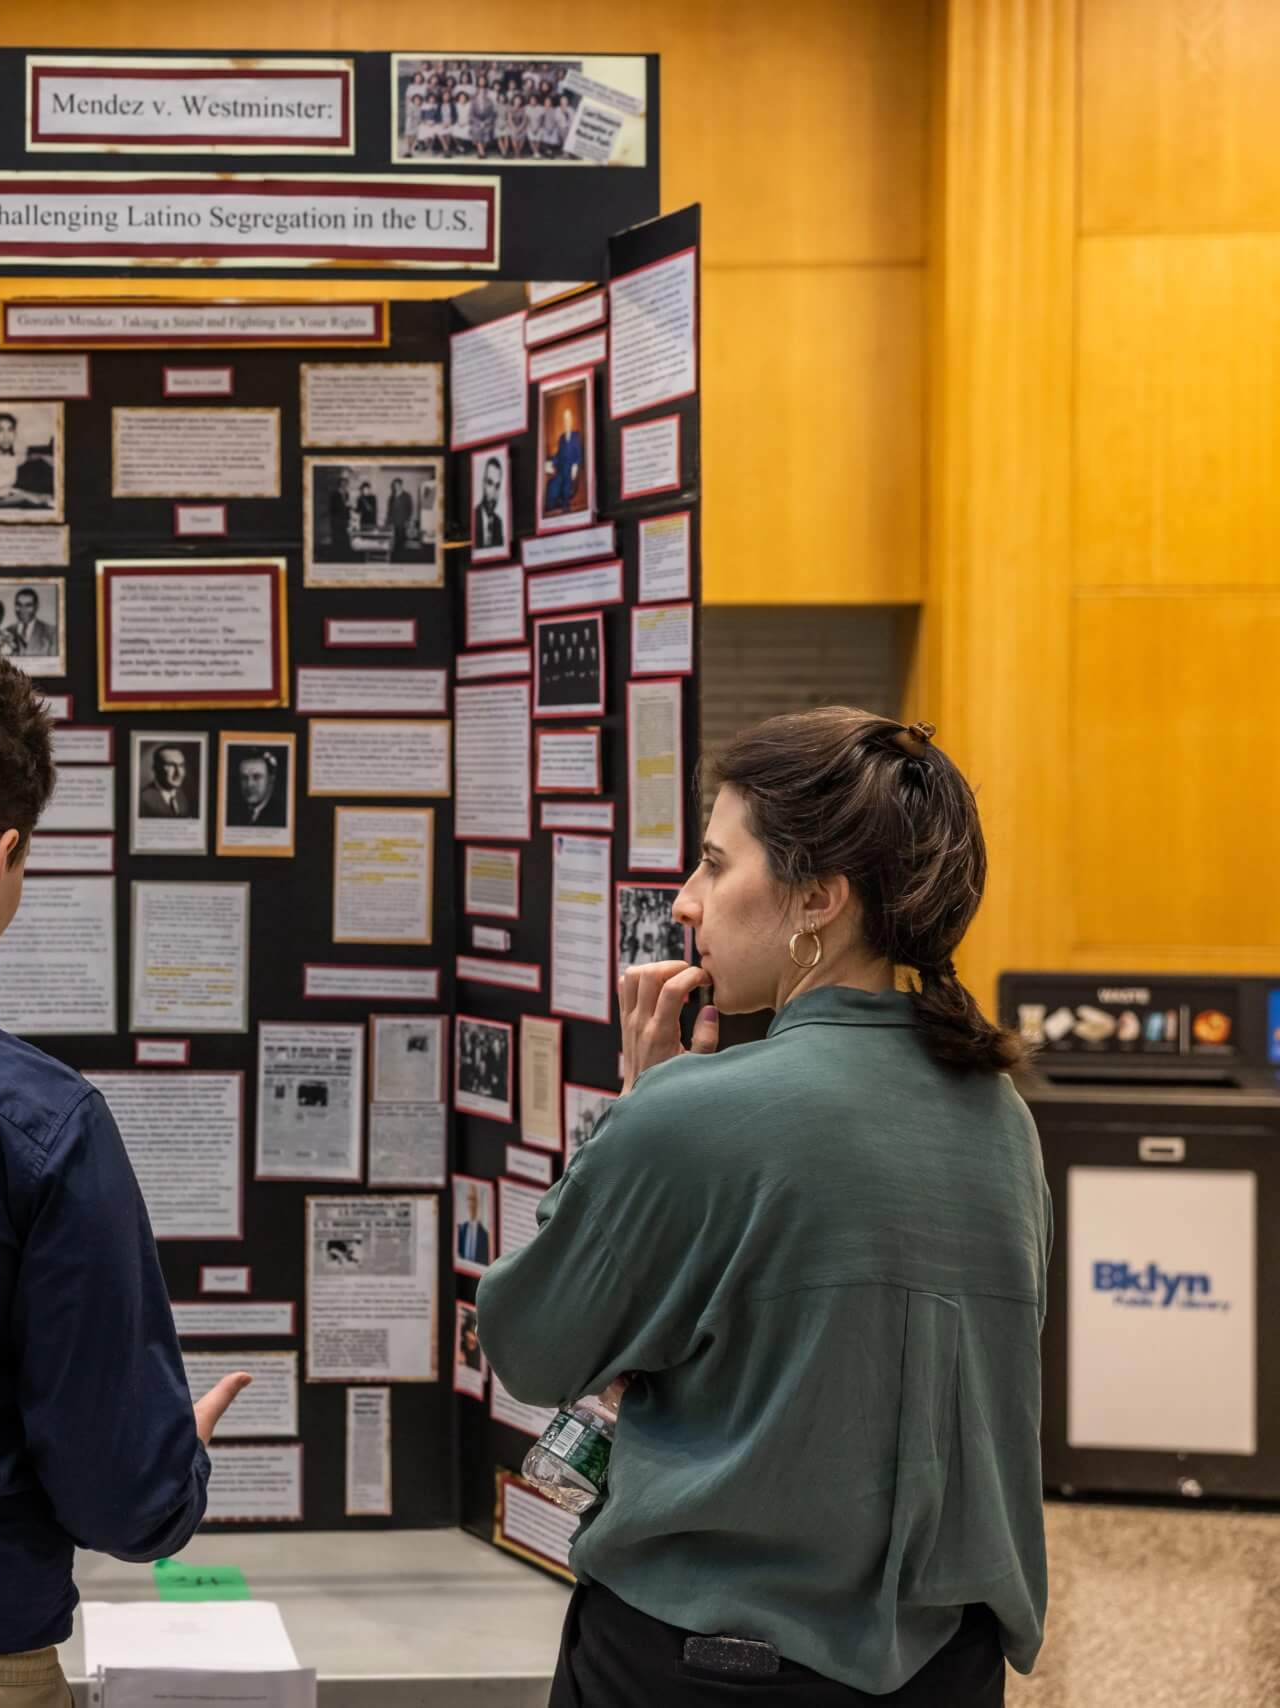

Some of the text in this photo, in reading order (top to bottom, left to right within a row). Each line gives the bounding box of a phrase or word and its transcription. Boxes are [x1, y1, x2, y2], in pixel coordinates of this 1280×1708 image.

[51, 93, 333, 120] Mendez v. Westminster:
[127, 205, 201, 228] Latino
[210, 206, 346, 235] Segregation
[353, 206, 374, 229] in
[382, 207, 417, 230] the
[425, 208, 474, 232] U.S.
[17, 315, 66, 327] Gonzalo
[122, 315, 160, 330] Taking
[163, 318, 170, 328] a
[174, 315, 205, 328] Stand
[207, 316, 226, 328] and
[229, 316, 276, 331] Fighting
[279, 316, 296, 328] for
[299, 317, 327, 329] Your
[330, 317, 368, 331] Rights
[1092, 1262, 1211, 1307] Bklyn
